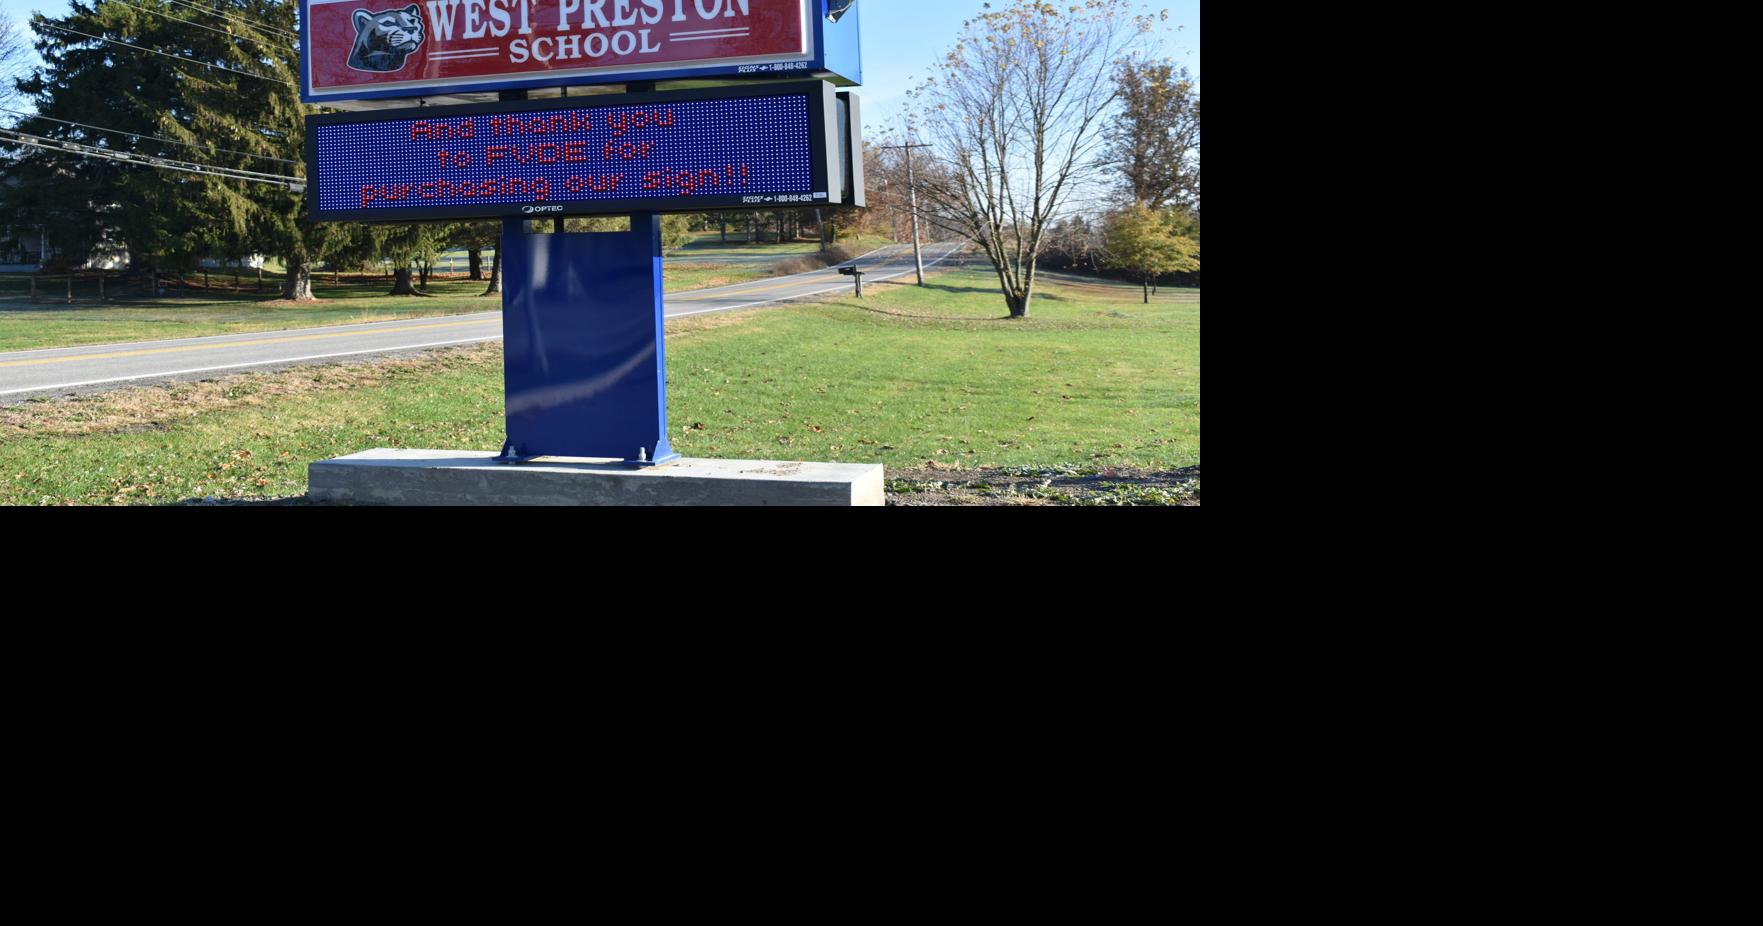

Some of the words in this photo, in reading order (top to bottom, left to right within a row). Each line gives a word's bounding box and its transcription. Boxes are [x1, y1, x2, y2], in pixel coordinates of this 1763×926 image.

[426, 0, 537, 42] WEST
[509, 29, 661, 63] SCHOOL
[410, 120, 475, 141] And
[490, 111, 591, 136] thank
[607, 108, 673, 137] you
[438, 149, 471, 169] to
[486, 140, 588, 167] FVDE
[603, 139, 656, 161] for
[361, 175, 549, 208] purchasing
[565, 172, 624, 193] our
[643, 163, 748, 196] sign!!
